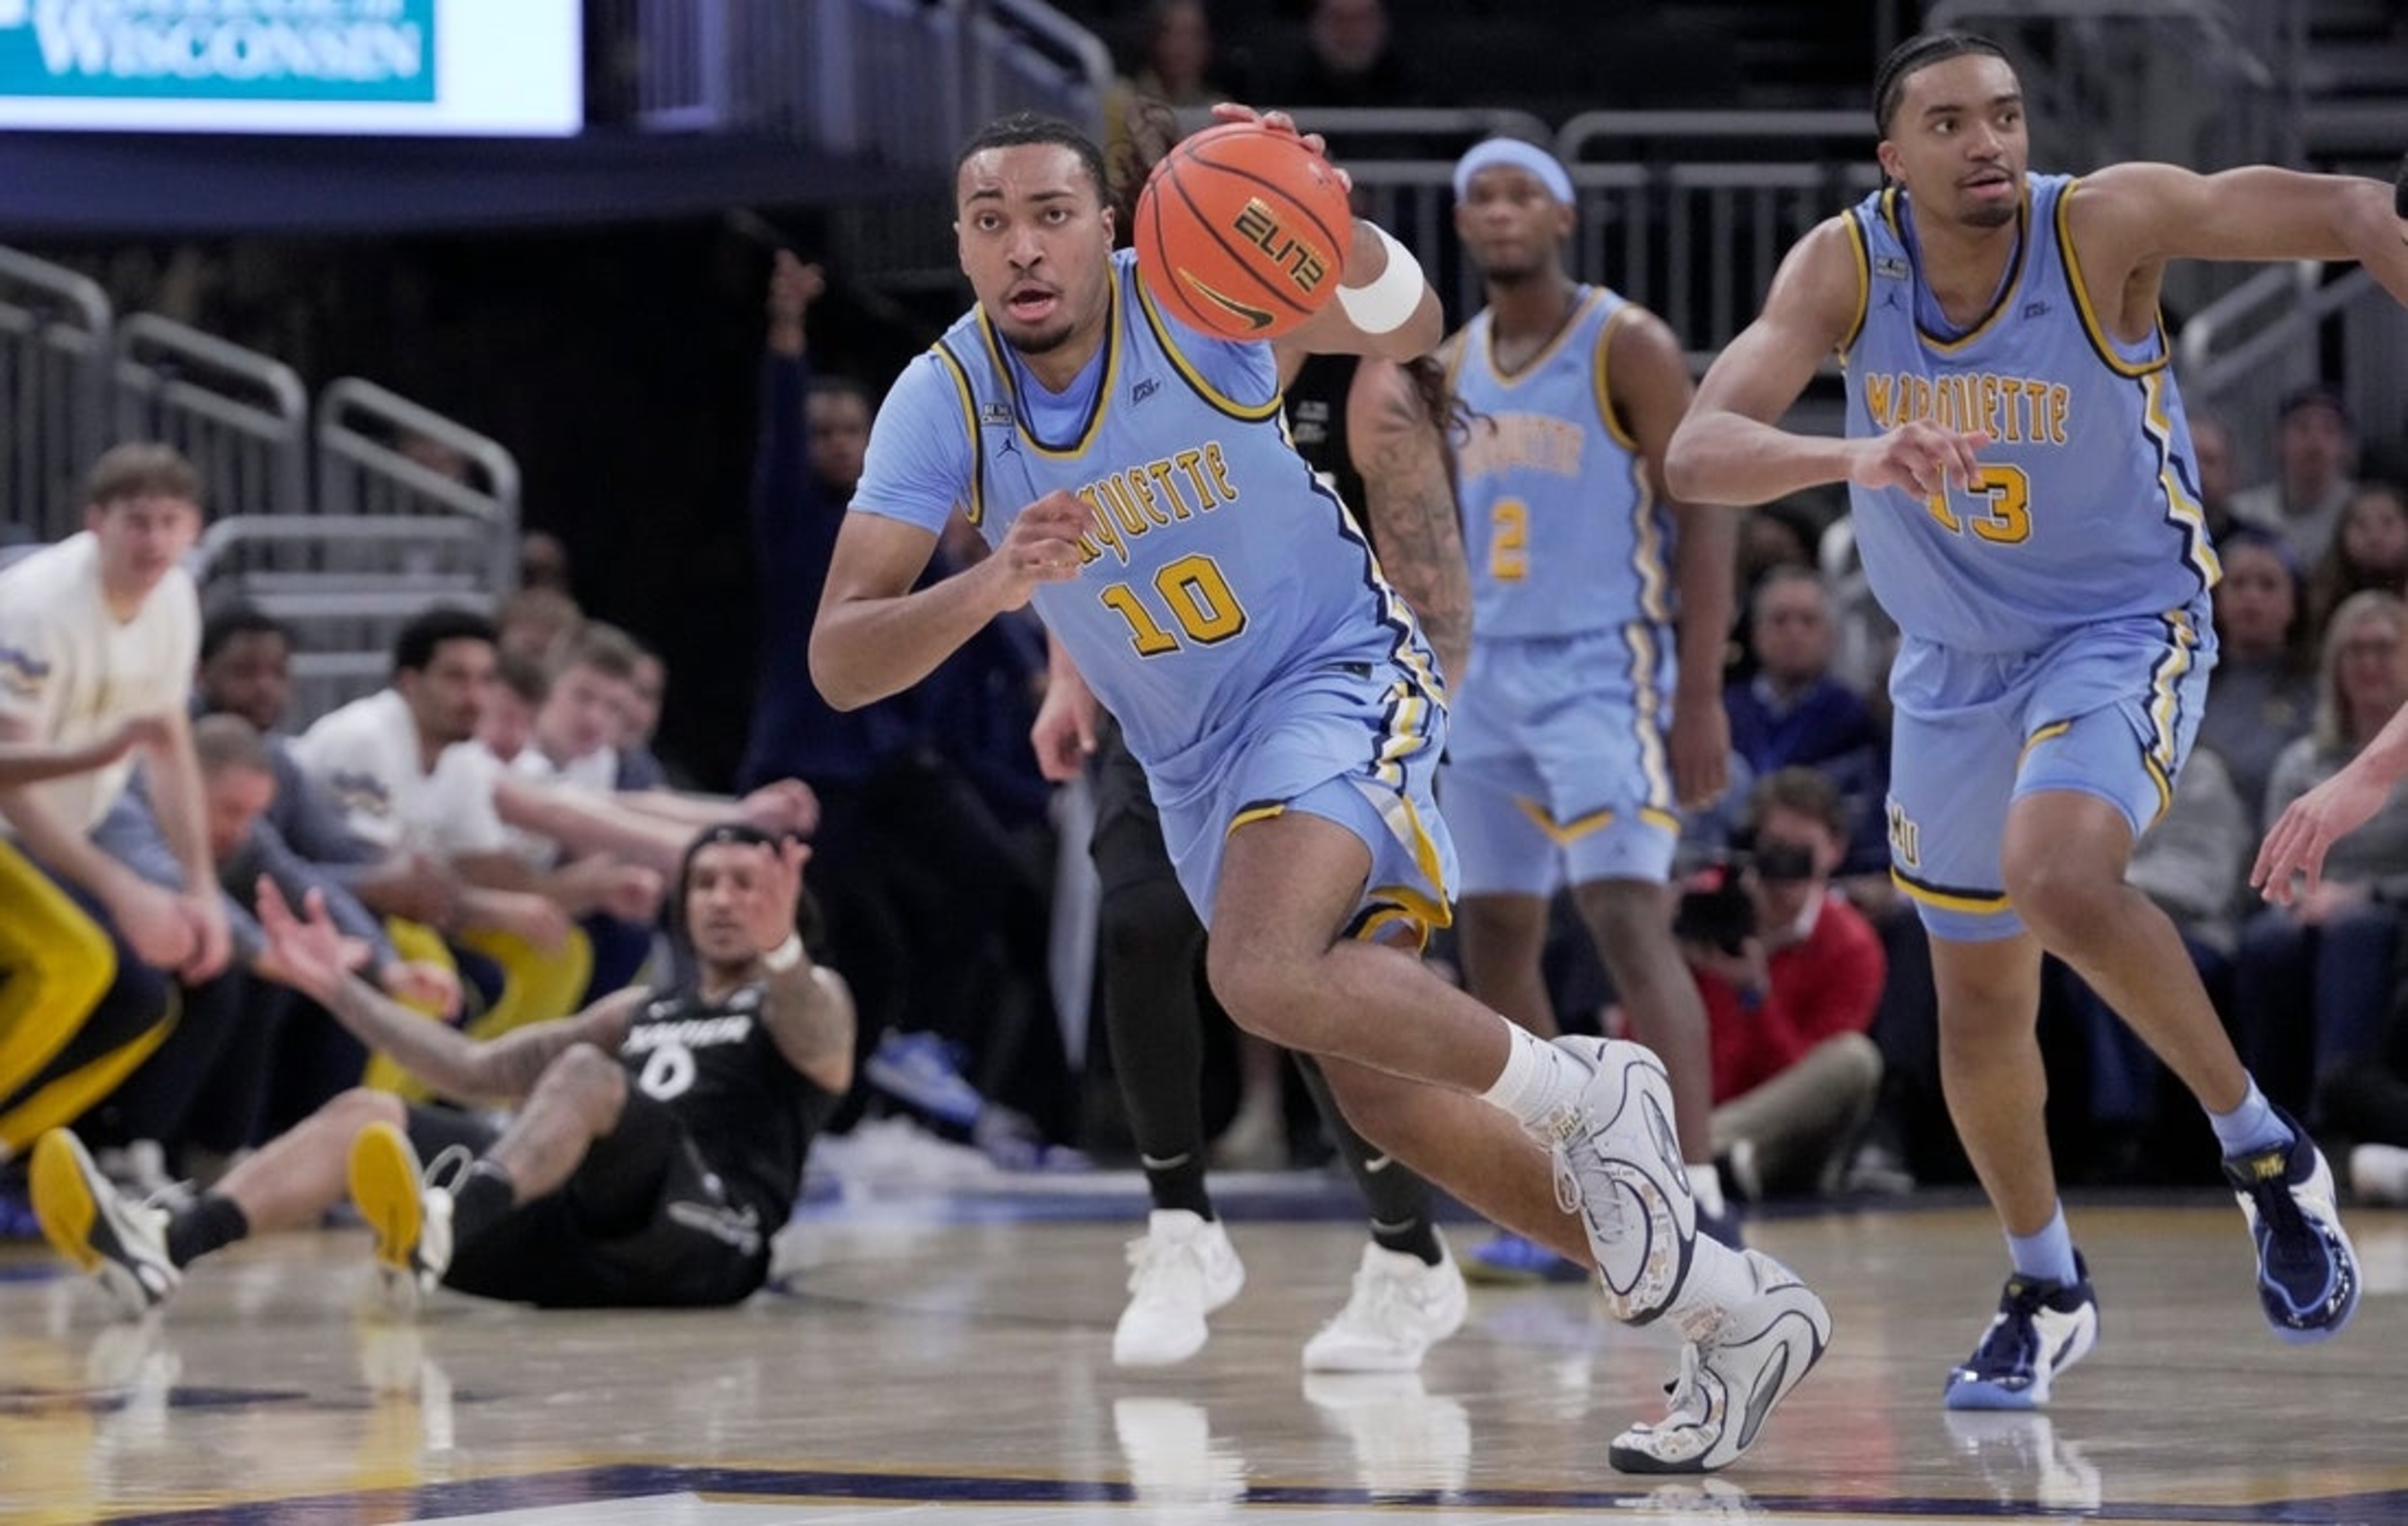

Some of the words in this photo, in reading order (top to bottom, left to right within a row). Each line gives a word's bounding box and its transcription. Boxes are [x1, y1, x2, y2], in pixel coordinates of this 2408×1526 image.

[34, 4, 422, 80] WISCONSIN
[1234, 204, 1325, 293] ELITE
[1866, 372, 2070, 445] MARQUETTE
[1076, 442, 1238, 566] QUETTE
[1490, 497, 1530, 583] 2
[1100, 553, 1249, 657] 10
[1888, 803, 1921, 868] MU
[639, 1041, 697, 1102] 0
